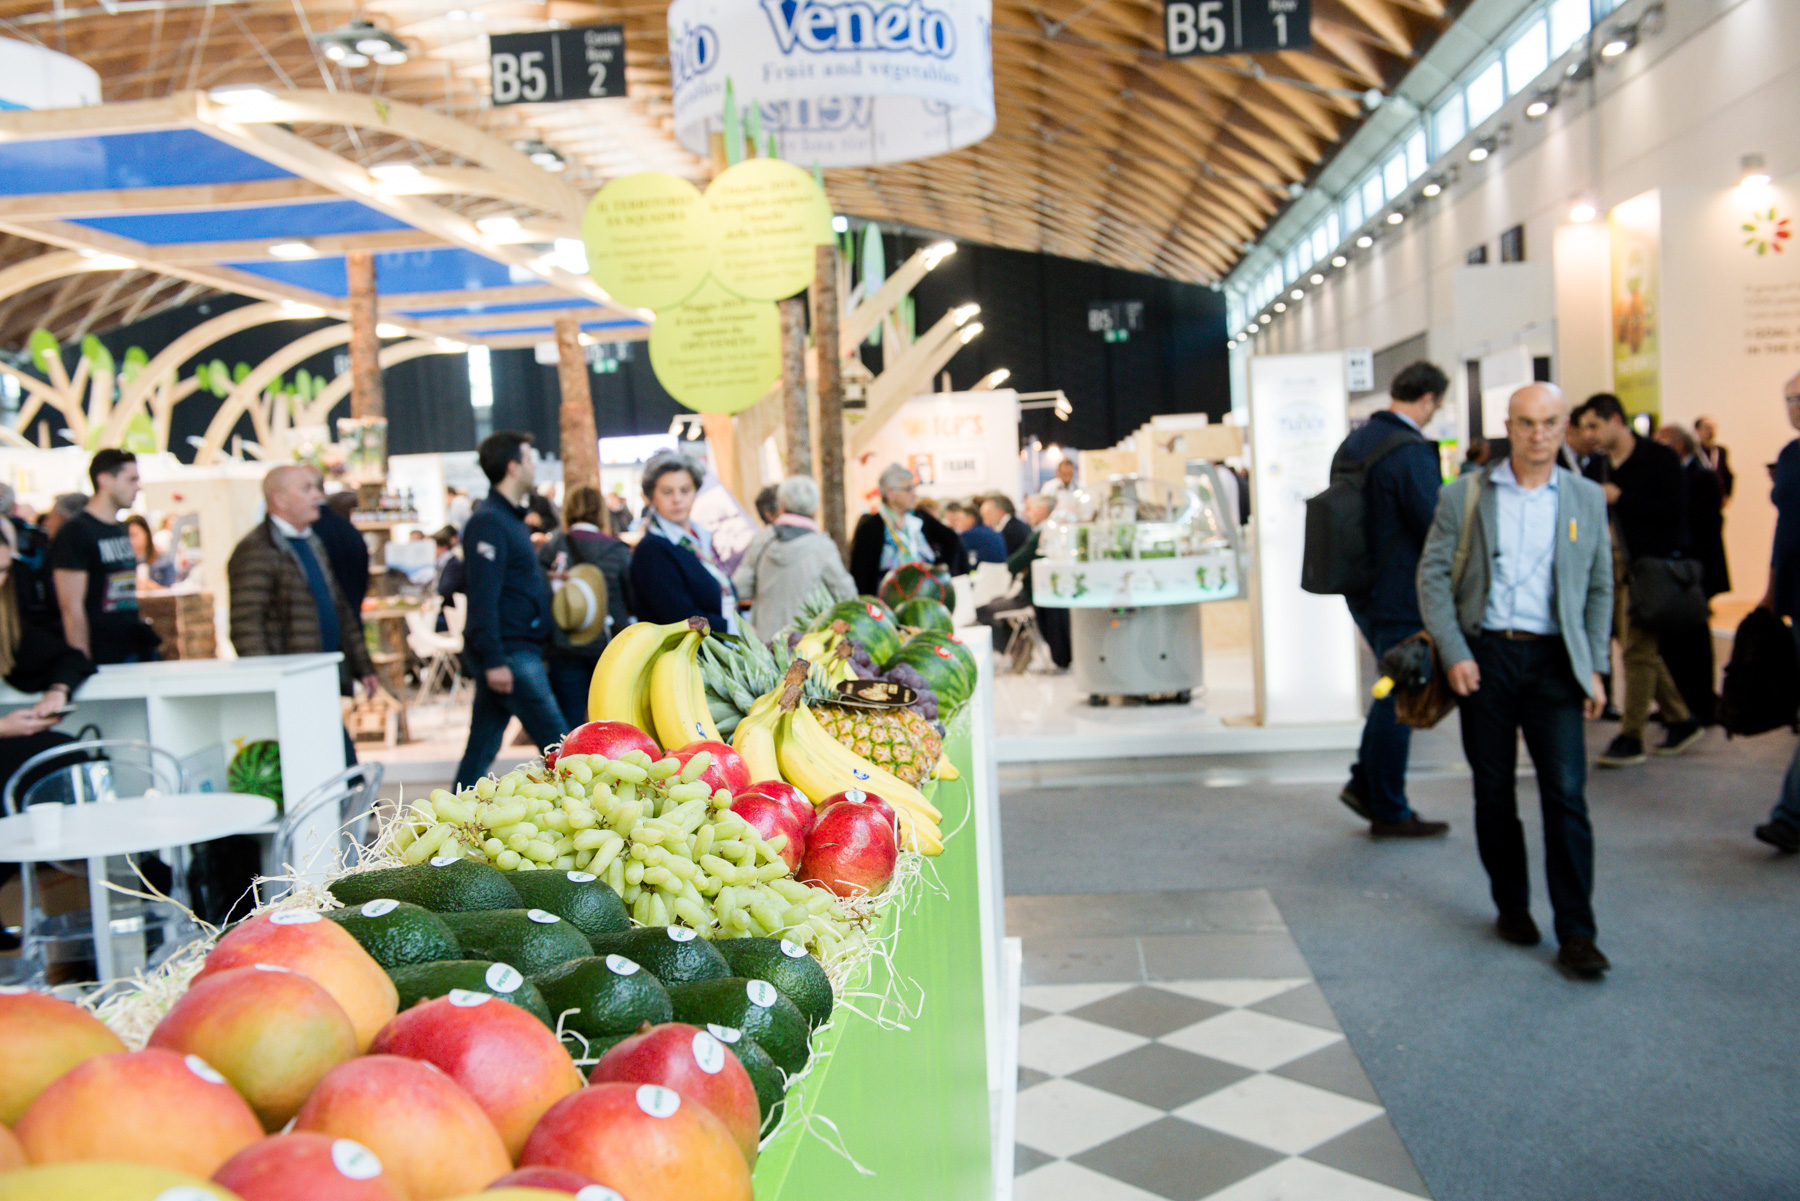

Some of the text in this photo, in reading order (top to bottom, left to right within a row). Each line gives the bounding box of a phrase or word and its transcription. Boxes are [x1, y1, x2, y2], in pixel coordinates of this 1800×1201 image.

[760, 0, 957, 59] Veneto
[1167, 2, 1226, 54] B5
[1273, 12, 1288, 47] 1
[492, 51, 548, 103] B5
[587, 62, 608, 97] 2
[762, 56, 960, 85] Fruit and vegetables
